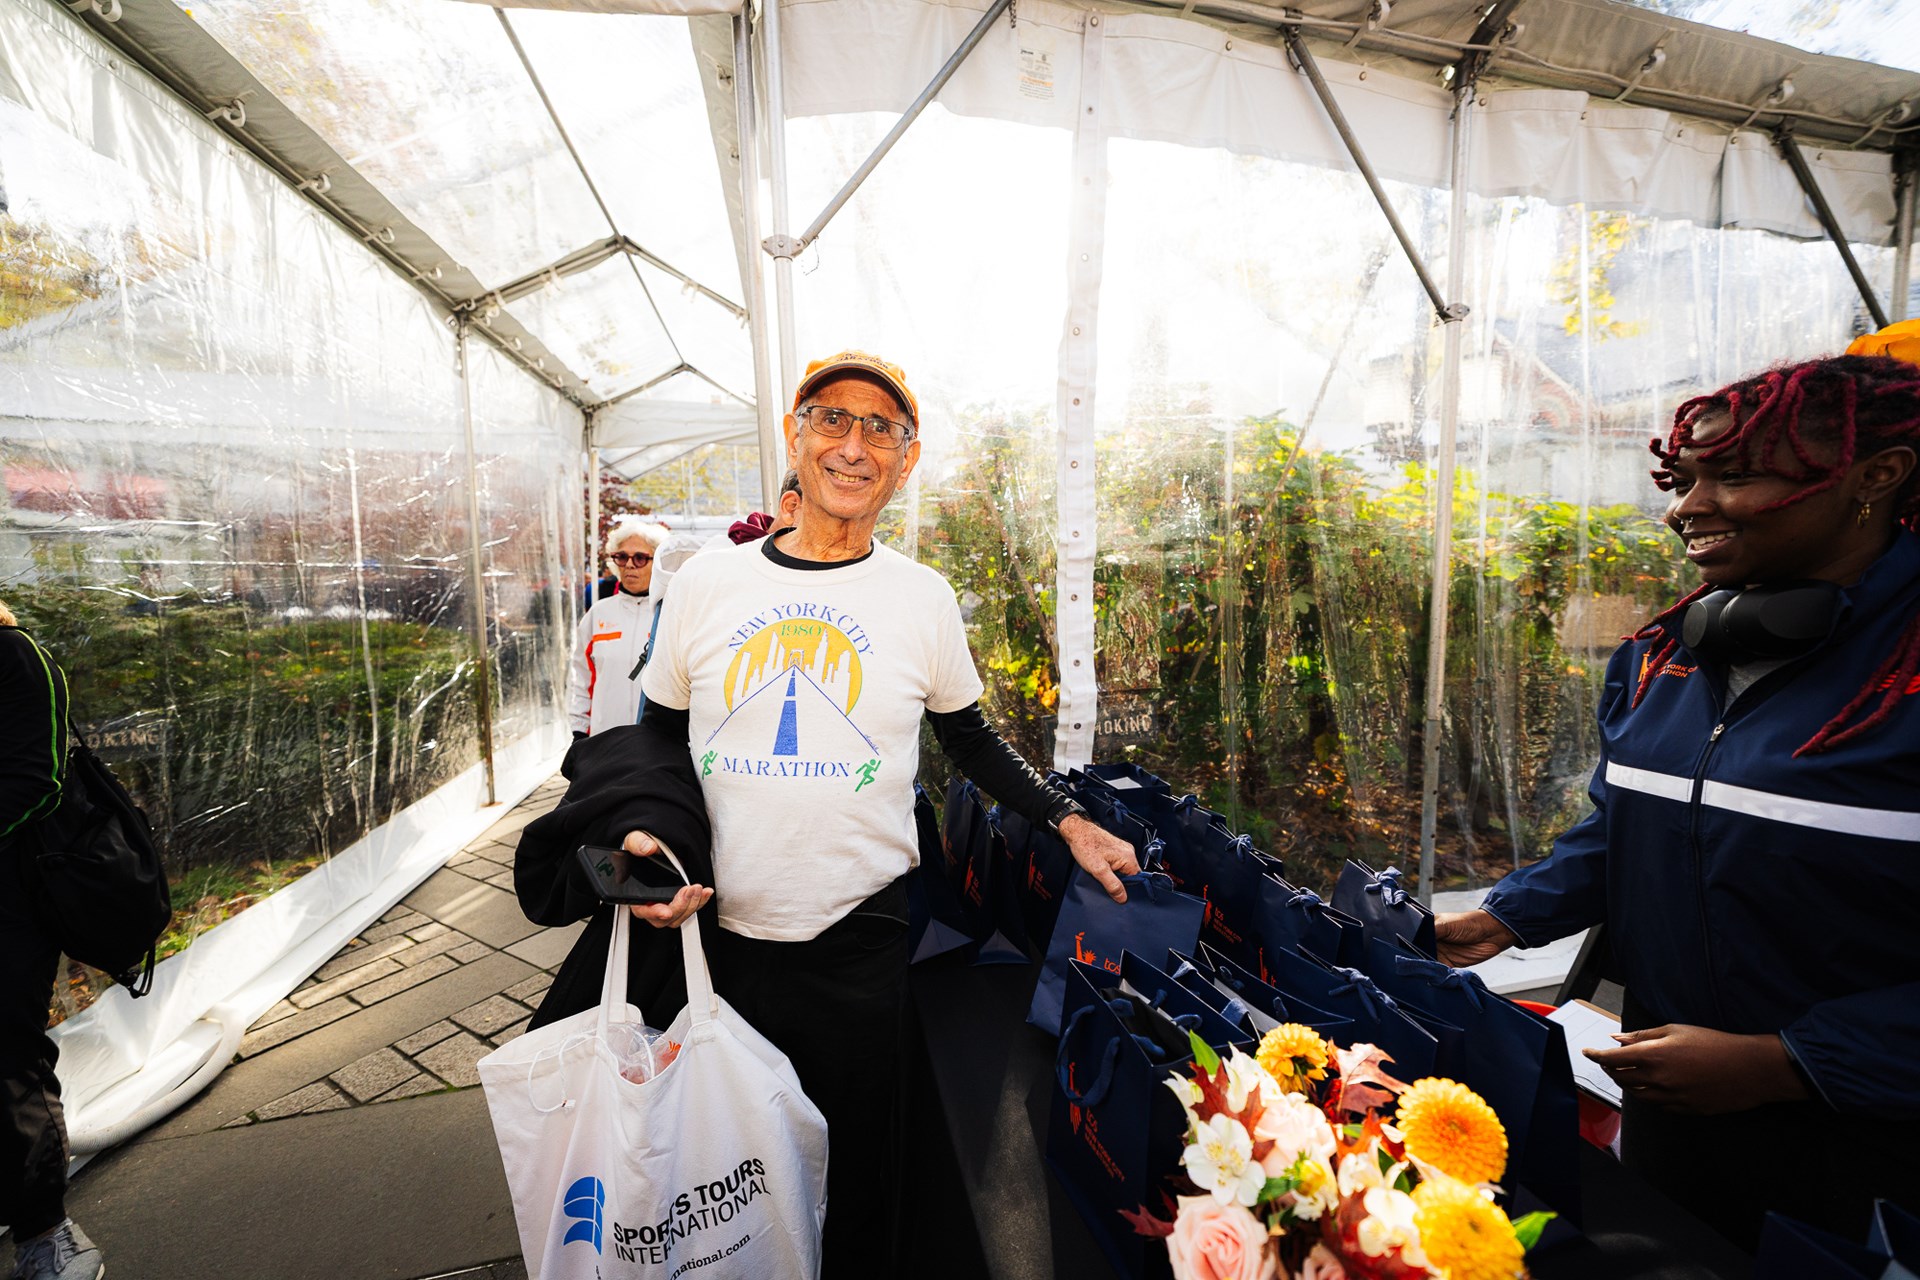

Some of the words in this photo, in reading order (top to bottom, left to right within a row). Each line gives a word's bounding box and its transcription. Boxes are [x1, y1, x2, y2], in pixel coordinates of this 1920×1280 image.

[728, 612, 767, 652] NEW
[773, 602, 836, 622] YORK
[838, 615, 873, 656] CITY
[781, 623, 822, 637] 1980
[723, 757, 851, 777] MARATHON
[1104, 957, 1121, 975] tcs
[1086, 1107, 1098, 1133] tcs
[694, 1158, 766, 1206] TOURS
[614, 1177, 771, 1265] INTERNATIONAL
